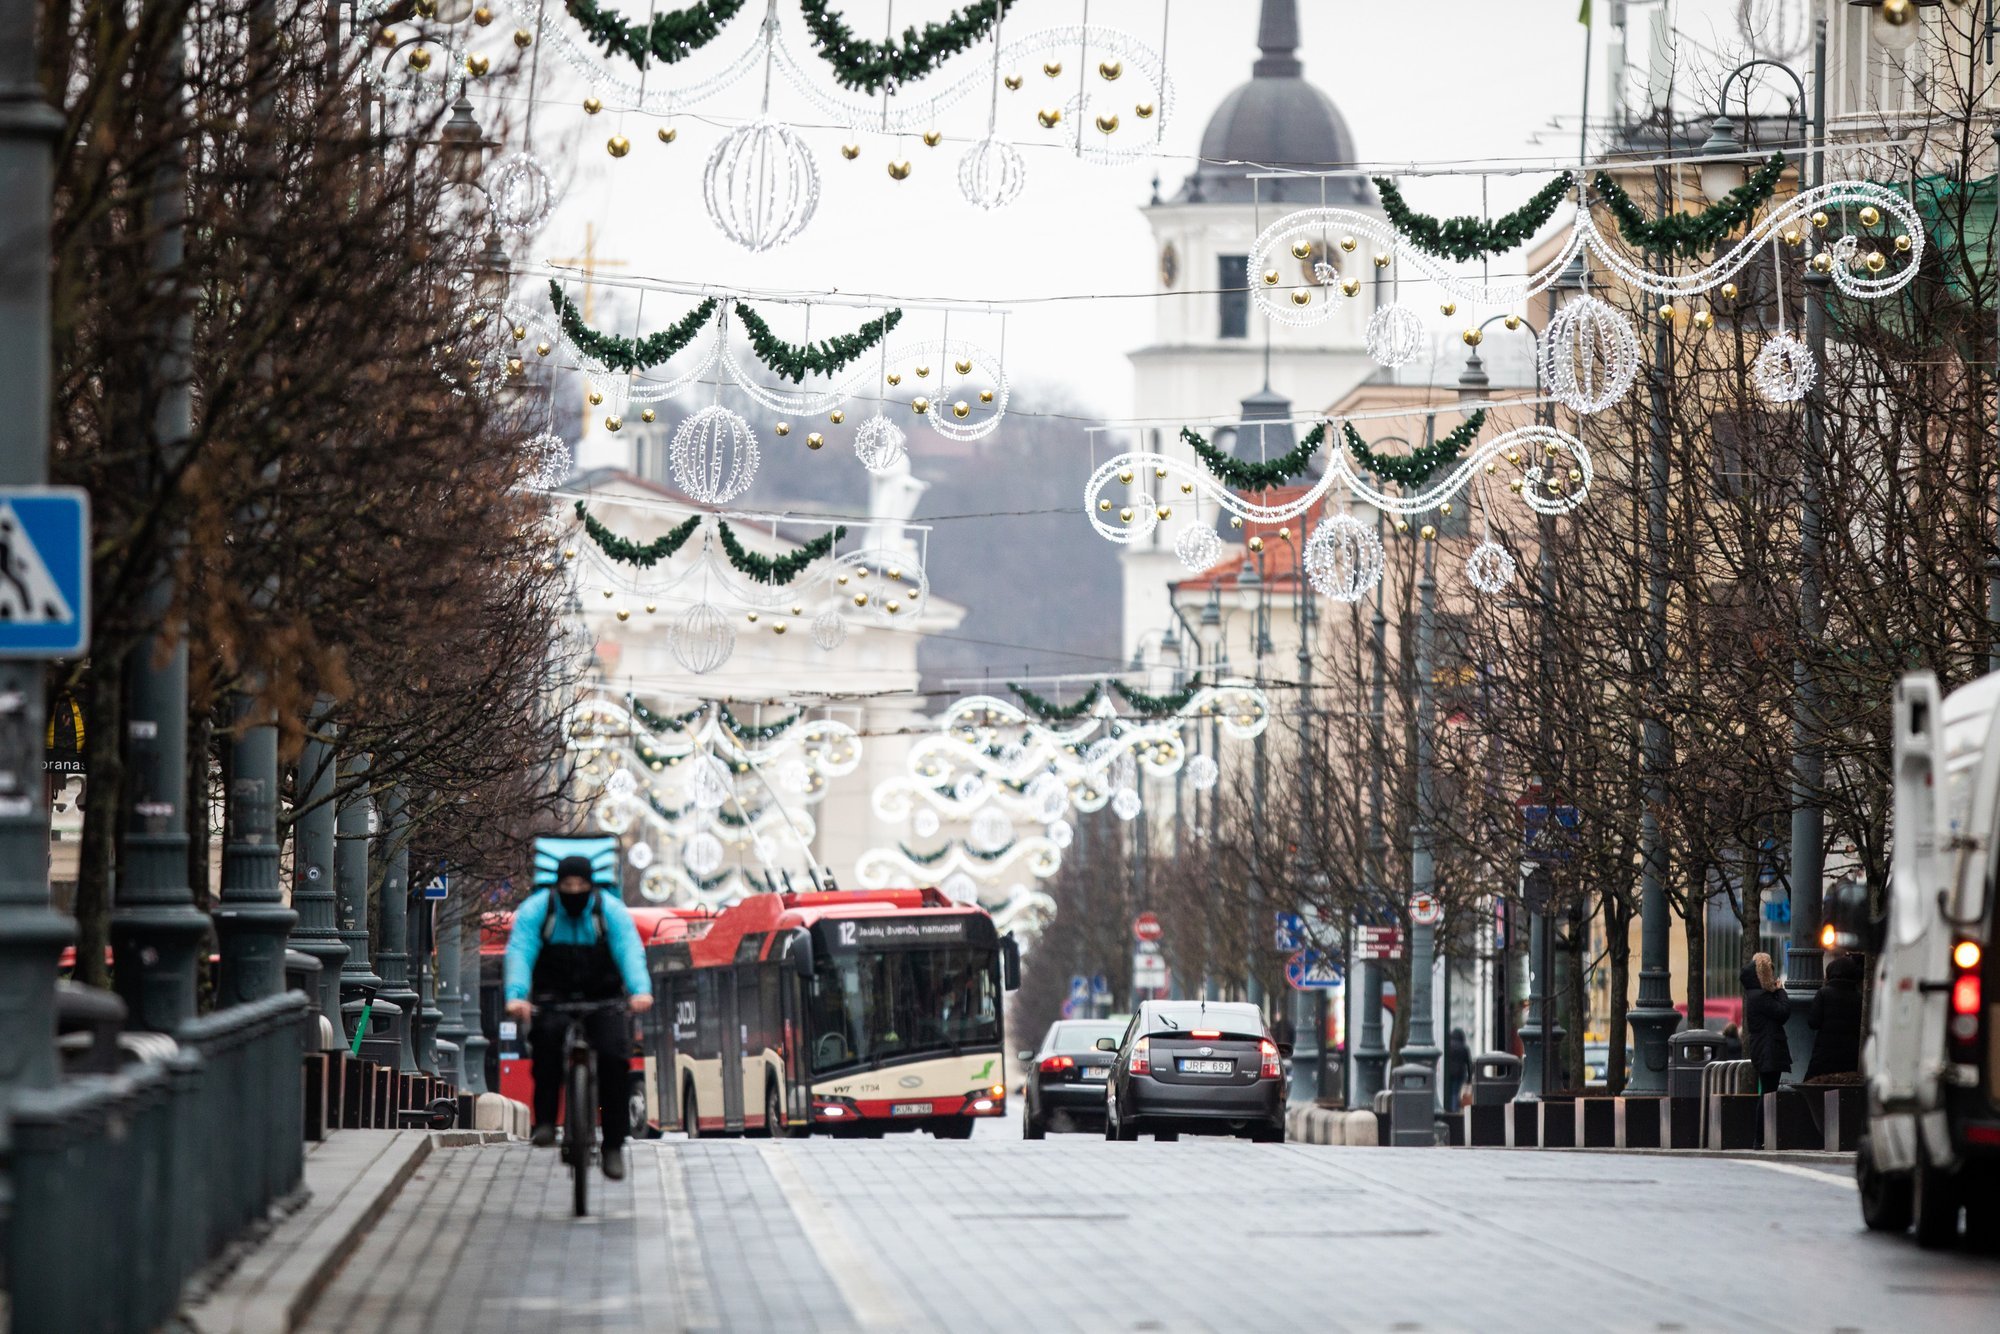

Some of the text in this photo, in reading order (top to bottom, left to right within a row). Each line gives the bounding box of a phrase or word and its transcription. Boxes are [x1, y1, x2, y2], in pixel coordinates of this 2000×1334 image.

[838, 921, 856, 945] 12
[1186, 1061, 1231, 1072] JRF 692
[861, 1084, 880, 1093] 1734
